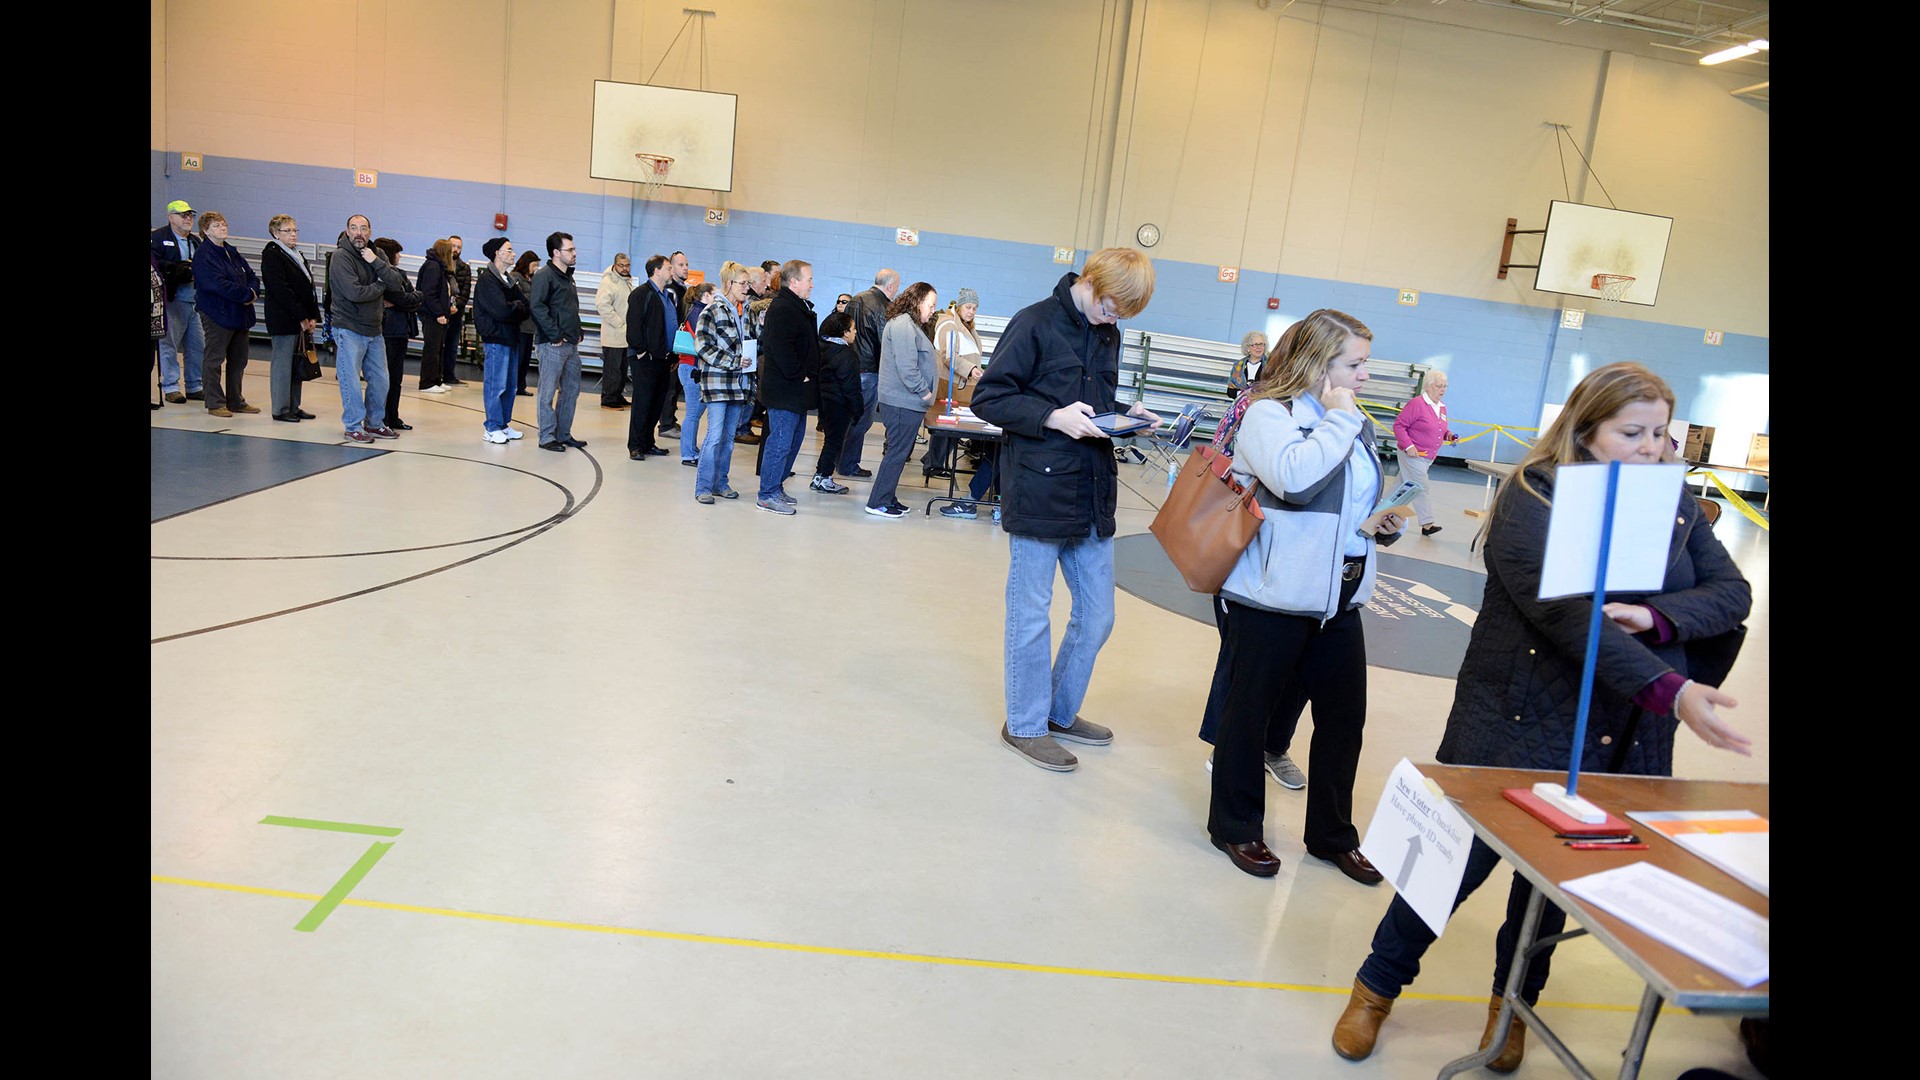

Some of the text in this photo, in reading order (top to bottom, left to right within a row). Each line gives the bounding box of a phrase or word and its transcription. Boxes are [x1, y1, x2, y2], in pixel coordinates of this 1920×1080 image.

[185, 158, 198, 167] Aa
[359, 173, 372, 183] Bb
[709, 210, 722, 221] Dd
[1058, 250, 1071, 260] Ff
[1222, 268, 1235, 280] Gg
[1376, 578, 1446, 619] ANCHESTER
[1397, 777, 1462, 846] New Voter Checklist
[1390, 794, 1454, 864] Have photo ID ready
